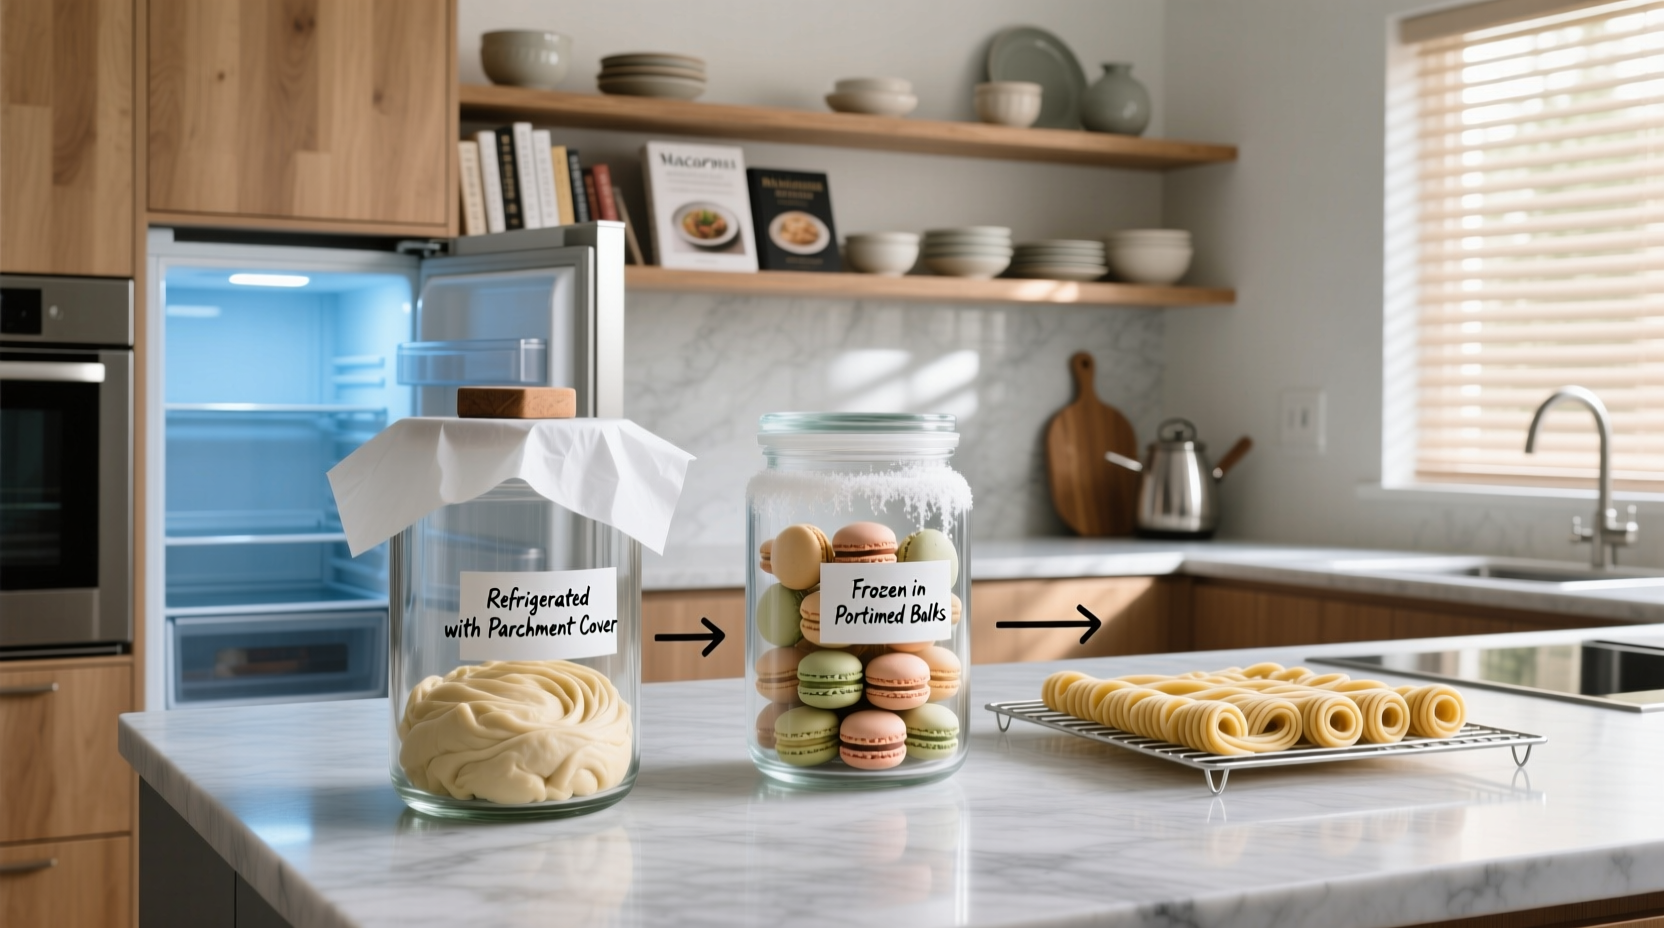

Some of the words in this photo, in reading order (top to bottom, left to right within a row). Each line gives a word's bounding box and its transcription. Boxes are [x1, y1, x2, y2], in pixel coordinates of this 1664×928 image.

[486, 585, 591, 616] Refrigerated
[851, 578, 907, 599] Frozen
[912, 578, 926, 597] in
[444, 616, 481, 638] with
[488, 616, 577, 638] Parchment
[579, 614, 618, 636] Cover
